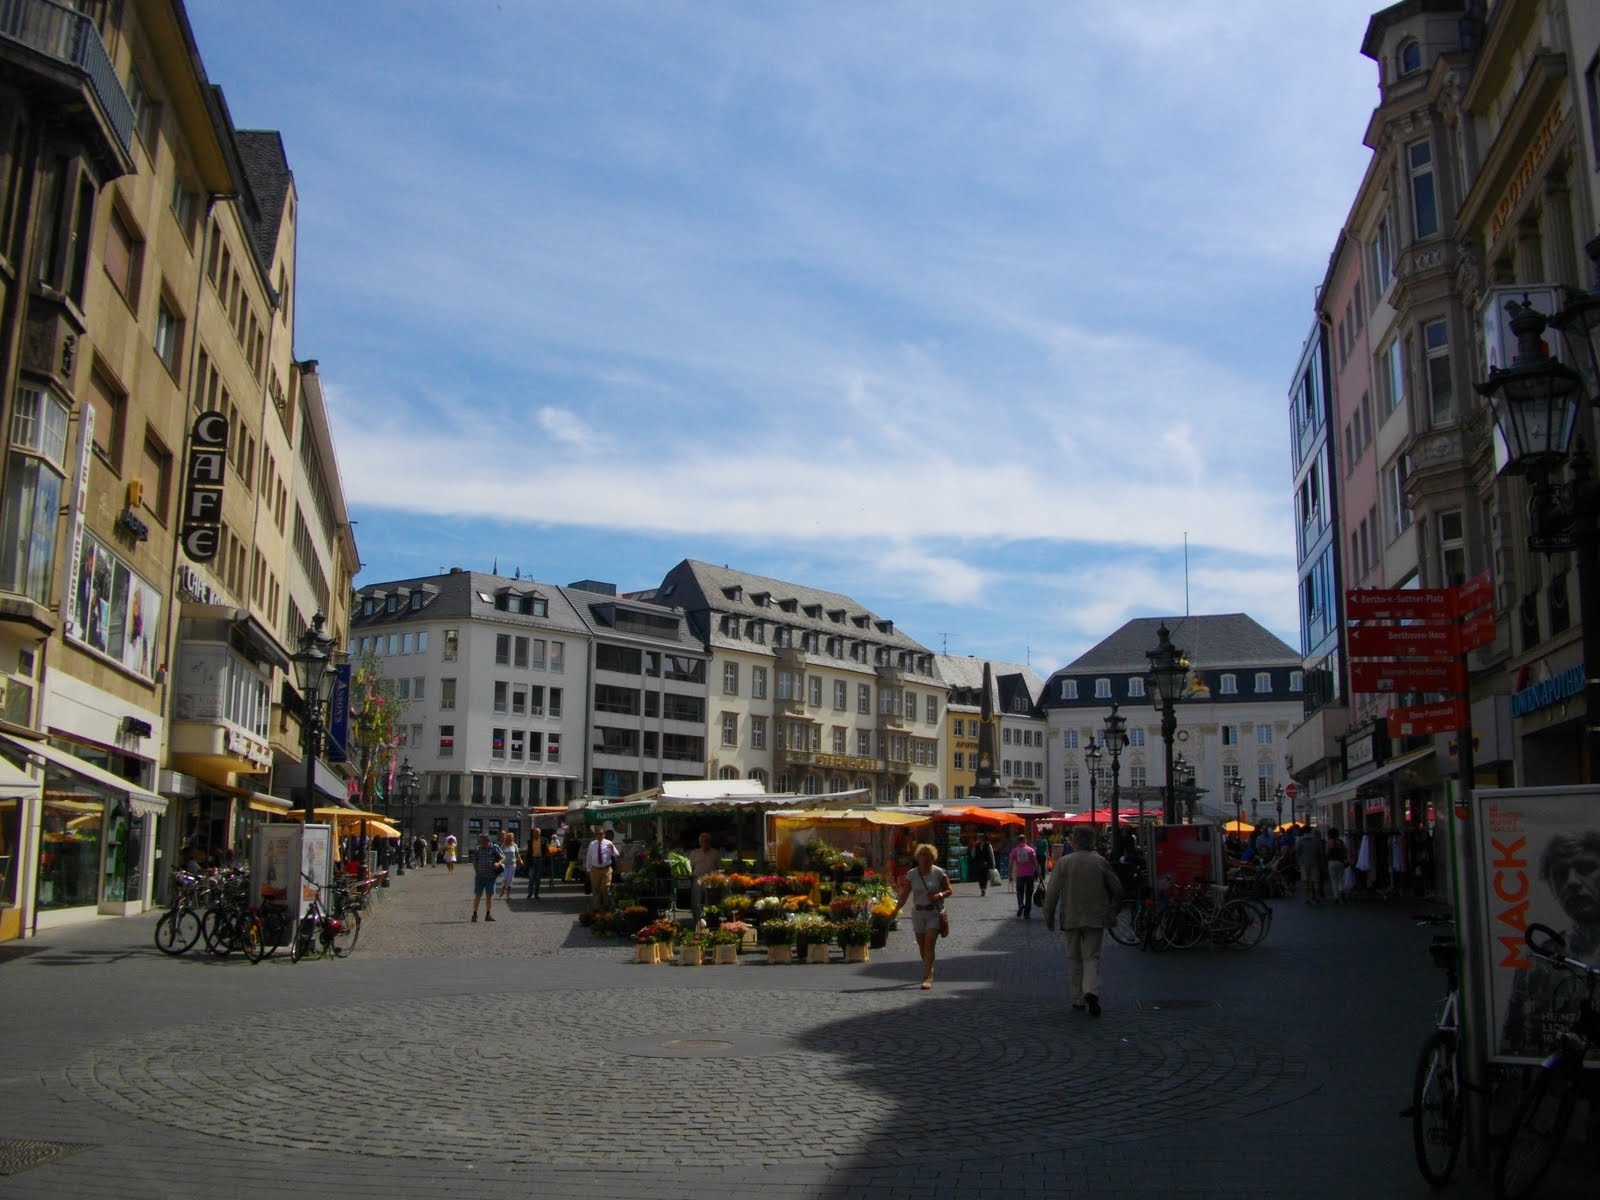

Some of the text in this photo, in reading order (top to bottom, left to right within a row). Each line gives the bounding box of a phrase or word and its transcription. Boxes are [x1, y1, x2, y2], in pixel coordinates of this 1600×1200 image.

[187, 416, 225, 556] CAFE
[1388, 631, 1447, 640] Beethoven-Haus
[1491, 835, 1535, 969] MACK
